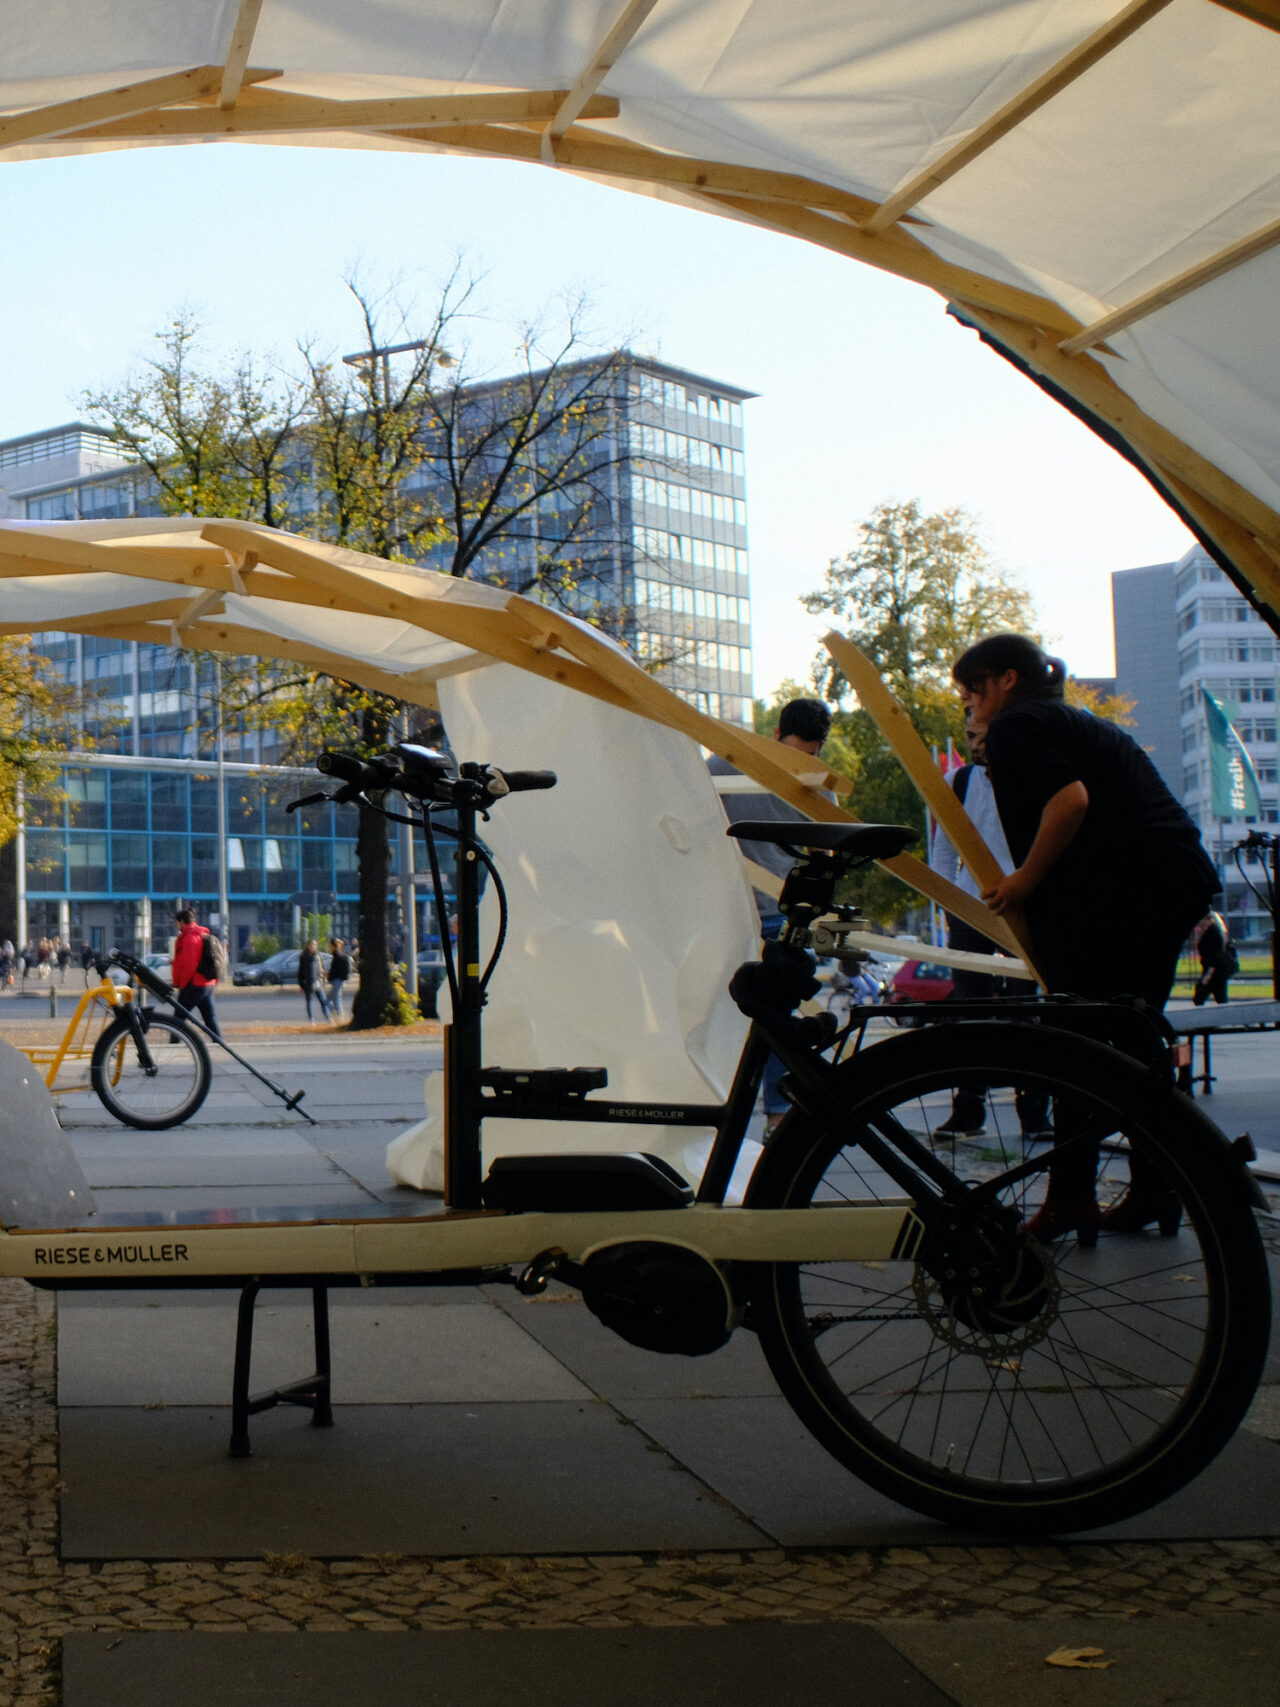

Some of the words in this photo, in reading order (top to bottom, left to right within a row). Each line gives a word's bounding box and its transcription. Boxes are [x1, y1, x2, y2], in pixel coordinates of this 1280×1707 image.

[608, 1108, 637, 1118] RIESE
[34, 1247, 91, 1265] RIESE
[107, 1244, 190, 1263] MÜLLER
